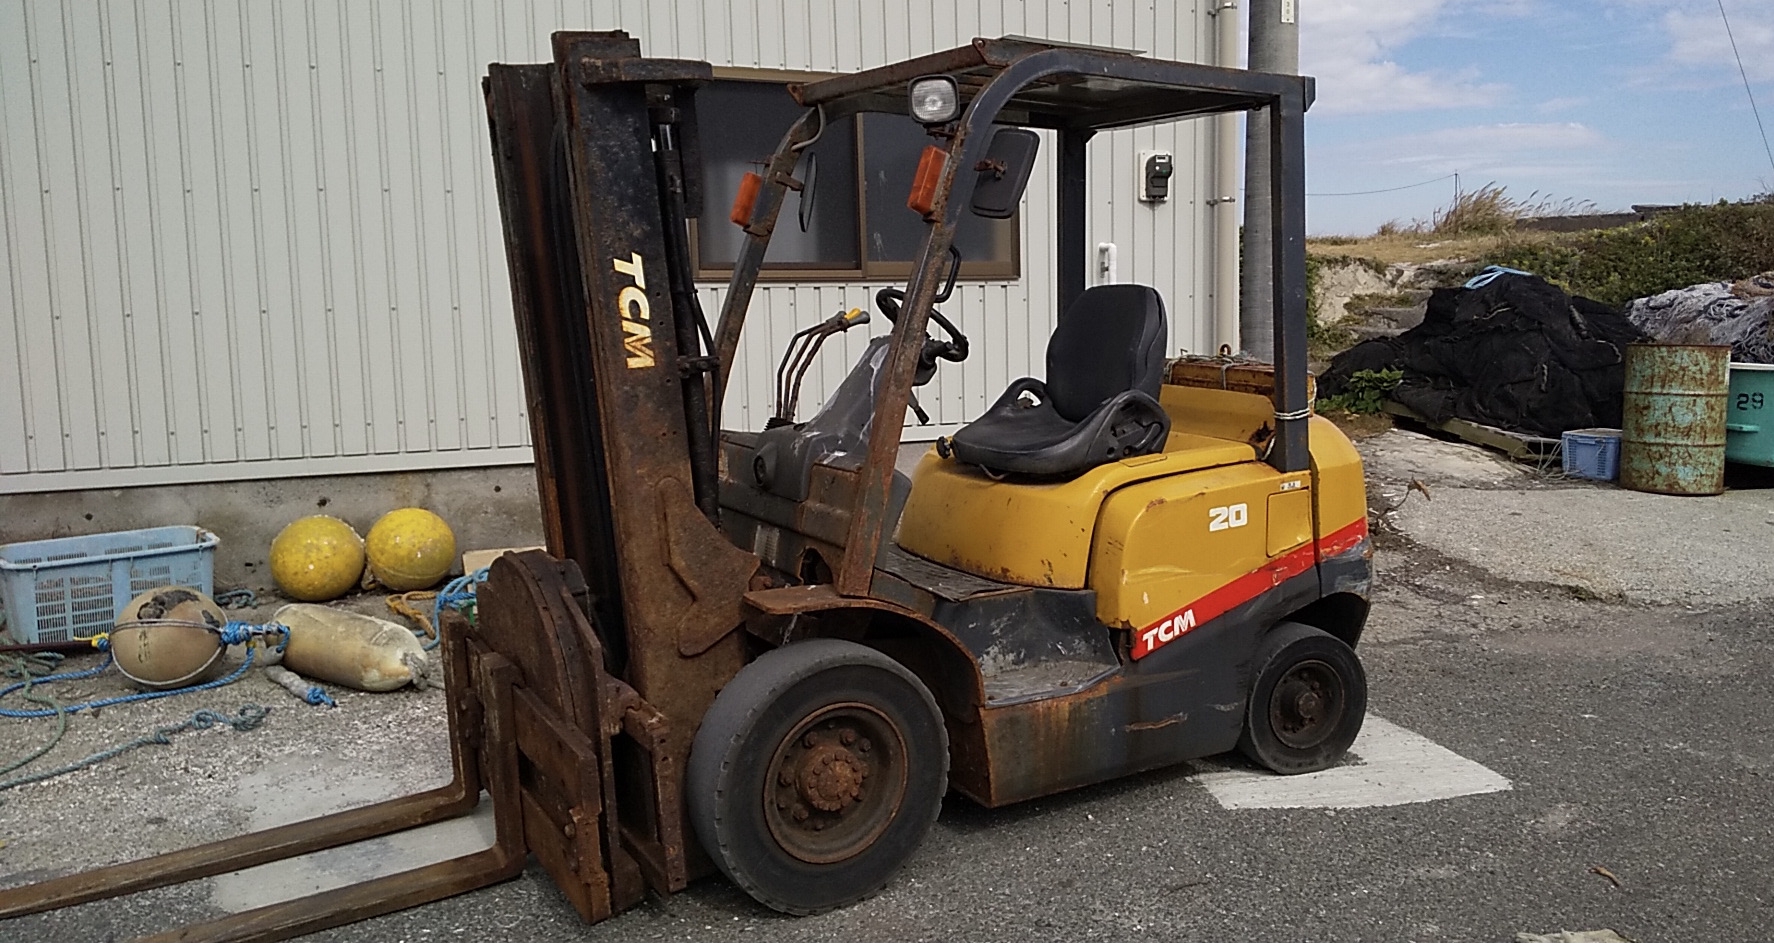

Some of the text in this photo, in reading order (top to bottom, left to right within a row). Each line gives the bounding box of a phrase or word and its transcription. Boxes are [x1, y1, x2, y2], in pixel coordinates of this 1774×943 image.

[613, 252, 655, 369] TCM
[1736, 392, 1764, 411] 29
[1209, 503, 1248, 532] 20
[1142, 609, 1196, 651] TCM
